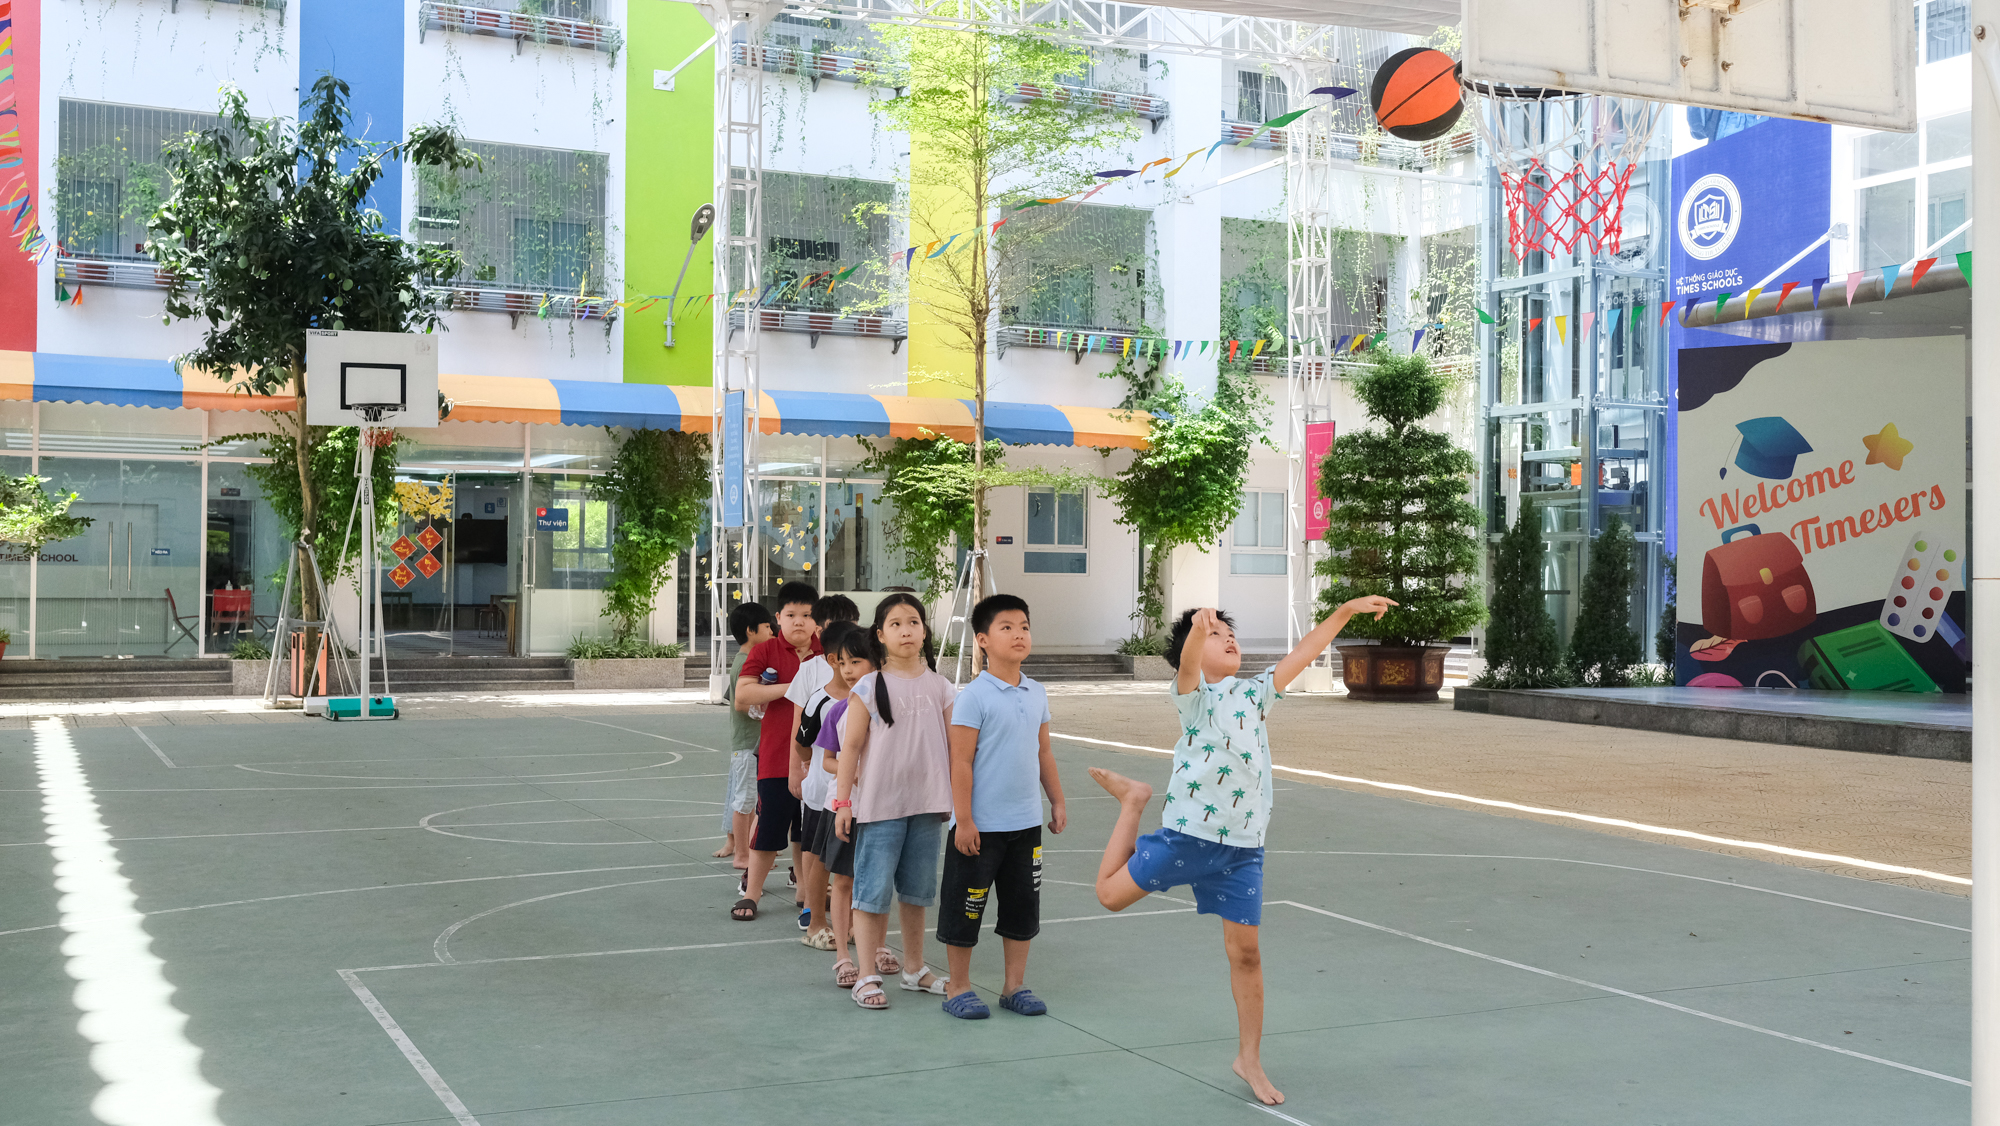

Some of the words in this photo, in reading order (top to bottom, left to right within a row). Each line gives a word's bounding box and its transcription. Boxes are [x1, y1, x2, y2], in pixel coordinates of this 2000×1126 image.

[1676, 282, 1700, 296] TIMES
[1701, 275, 1743, 292] SCHOOLS
[1699, 459, 1856, 530] Welcome
[538, 519, 552, 527] Thư
[553, 519, 567, 528] viện
[1790, 483, 1947, 555] Timesers
[0, 553, 31, 562] TIMES
